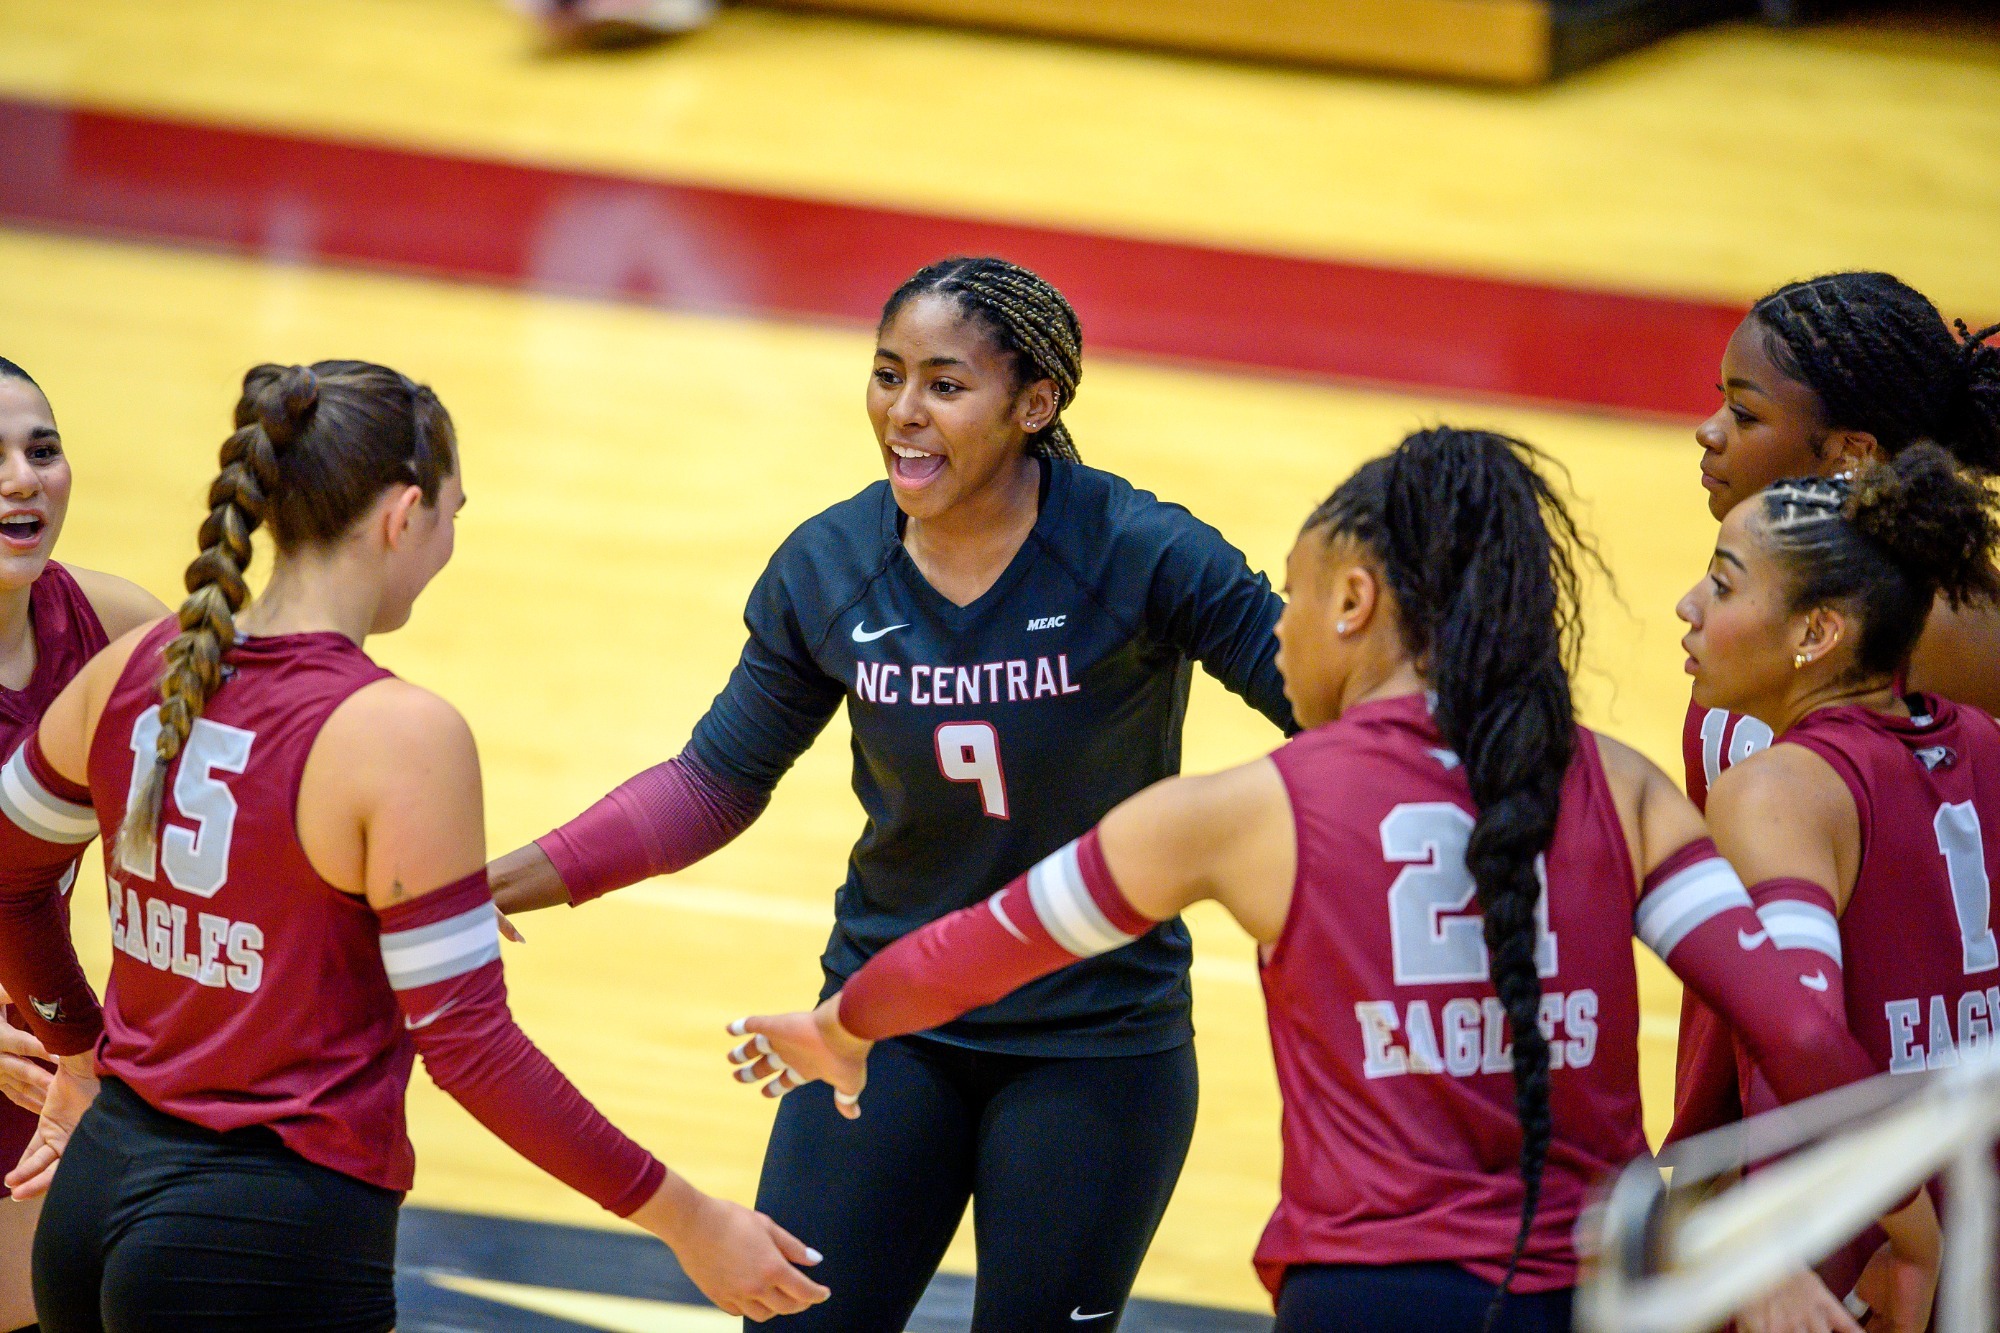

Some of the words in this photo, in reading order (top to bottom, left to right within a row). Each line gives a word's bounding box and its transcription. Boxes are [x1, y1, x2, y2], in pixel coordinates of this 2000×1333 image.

[1026, 614, 1066, 632] MEAC
[856, 660, 901, 703] NC
[910, 653, 1081, 705] CENTRAL
[120, 703, 257, 899] 15
[934, 720, 1010, 820] 9
[108, 875, 265, 994] EAGLES
[1933, 799, 1999, 975] 1
[1354, 988, 1599, 1079] EAGLES
